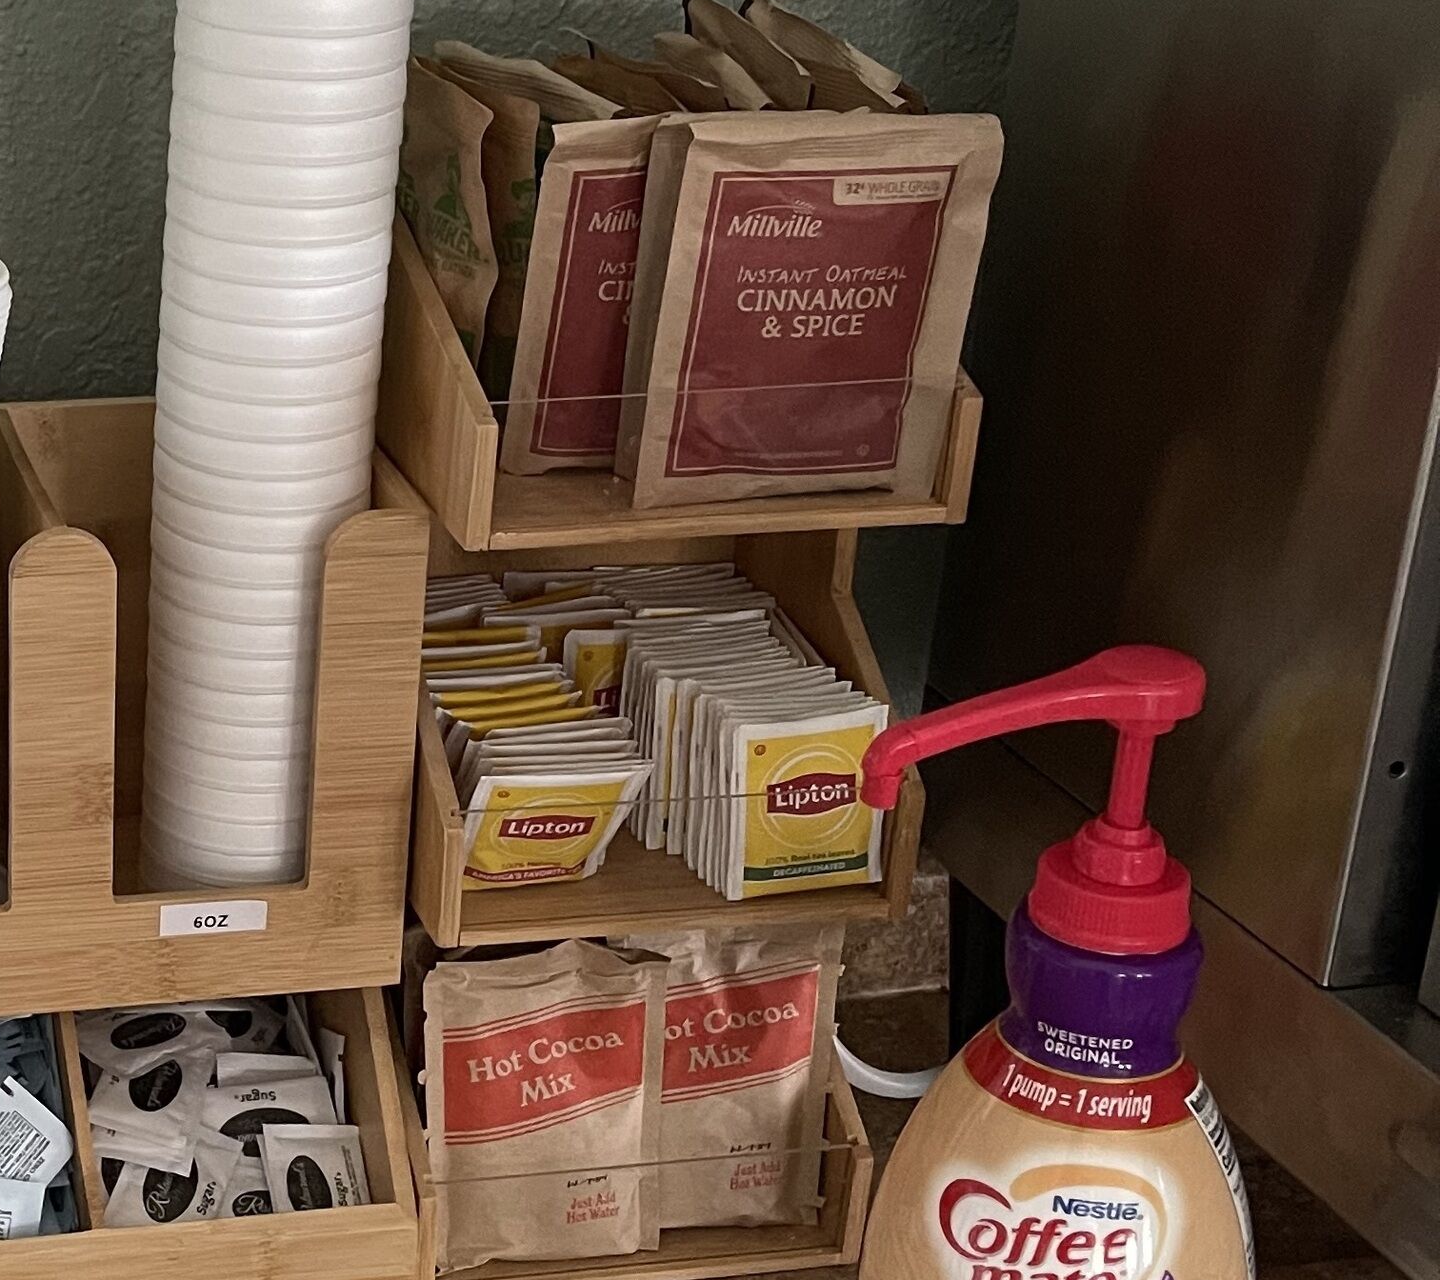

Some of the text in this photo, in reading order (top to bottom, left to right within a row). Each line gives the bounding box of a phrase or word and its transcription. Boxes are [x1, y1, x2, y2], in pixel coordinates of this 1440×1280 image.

[727, 213, 823, 238] Millville
[737, 285, 898, 312] CINNAMON
[761, 314, 865, 338] & SPICE
[775, 782, 850, 810] Lipton
[508, 820, 586, 837] Lipton
[194, 915, 229, 928] 6OZ
[664, 1001, 799, 1041] ot Cocoa
[1037, 1020, 1134, 1050] SWEETENED
[467, 1029, 624, 1083] Hot Cocoa
[687, 1043, 752, 1073] Mix
[1044, 1037, 1121, 1066] ORIGINAL
[520, 1071, 577, 1107] Mix
[1002, 1063, 1016, 1088] 1
[240, 1089, 277, 1103] Sugar
[1007, 1073, 1058, 1112] pump
[1076, 1088, 1088, 1114] 1
[1087, 1088, 1153, 1124] serving
[196, 1180, 217, 1216] Sugar
[590, 1204, 620, 1221] Water
[939, 1177, 1137, 1267] Coffee
